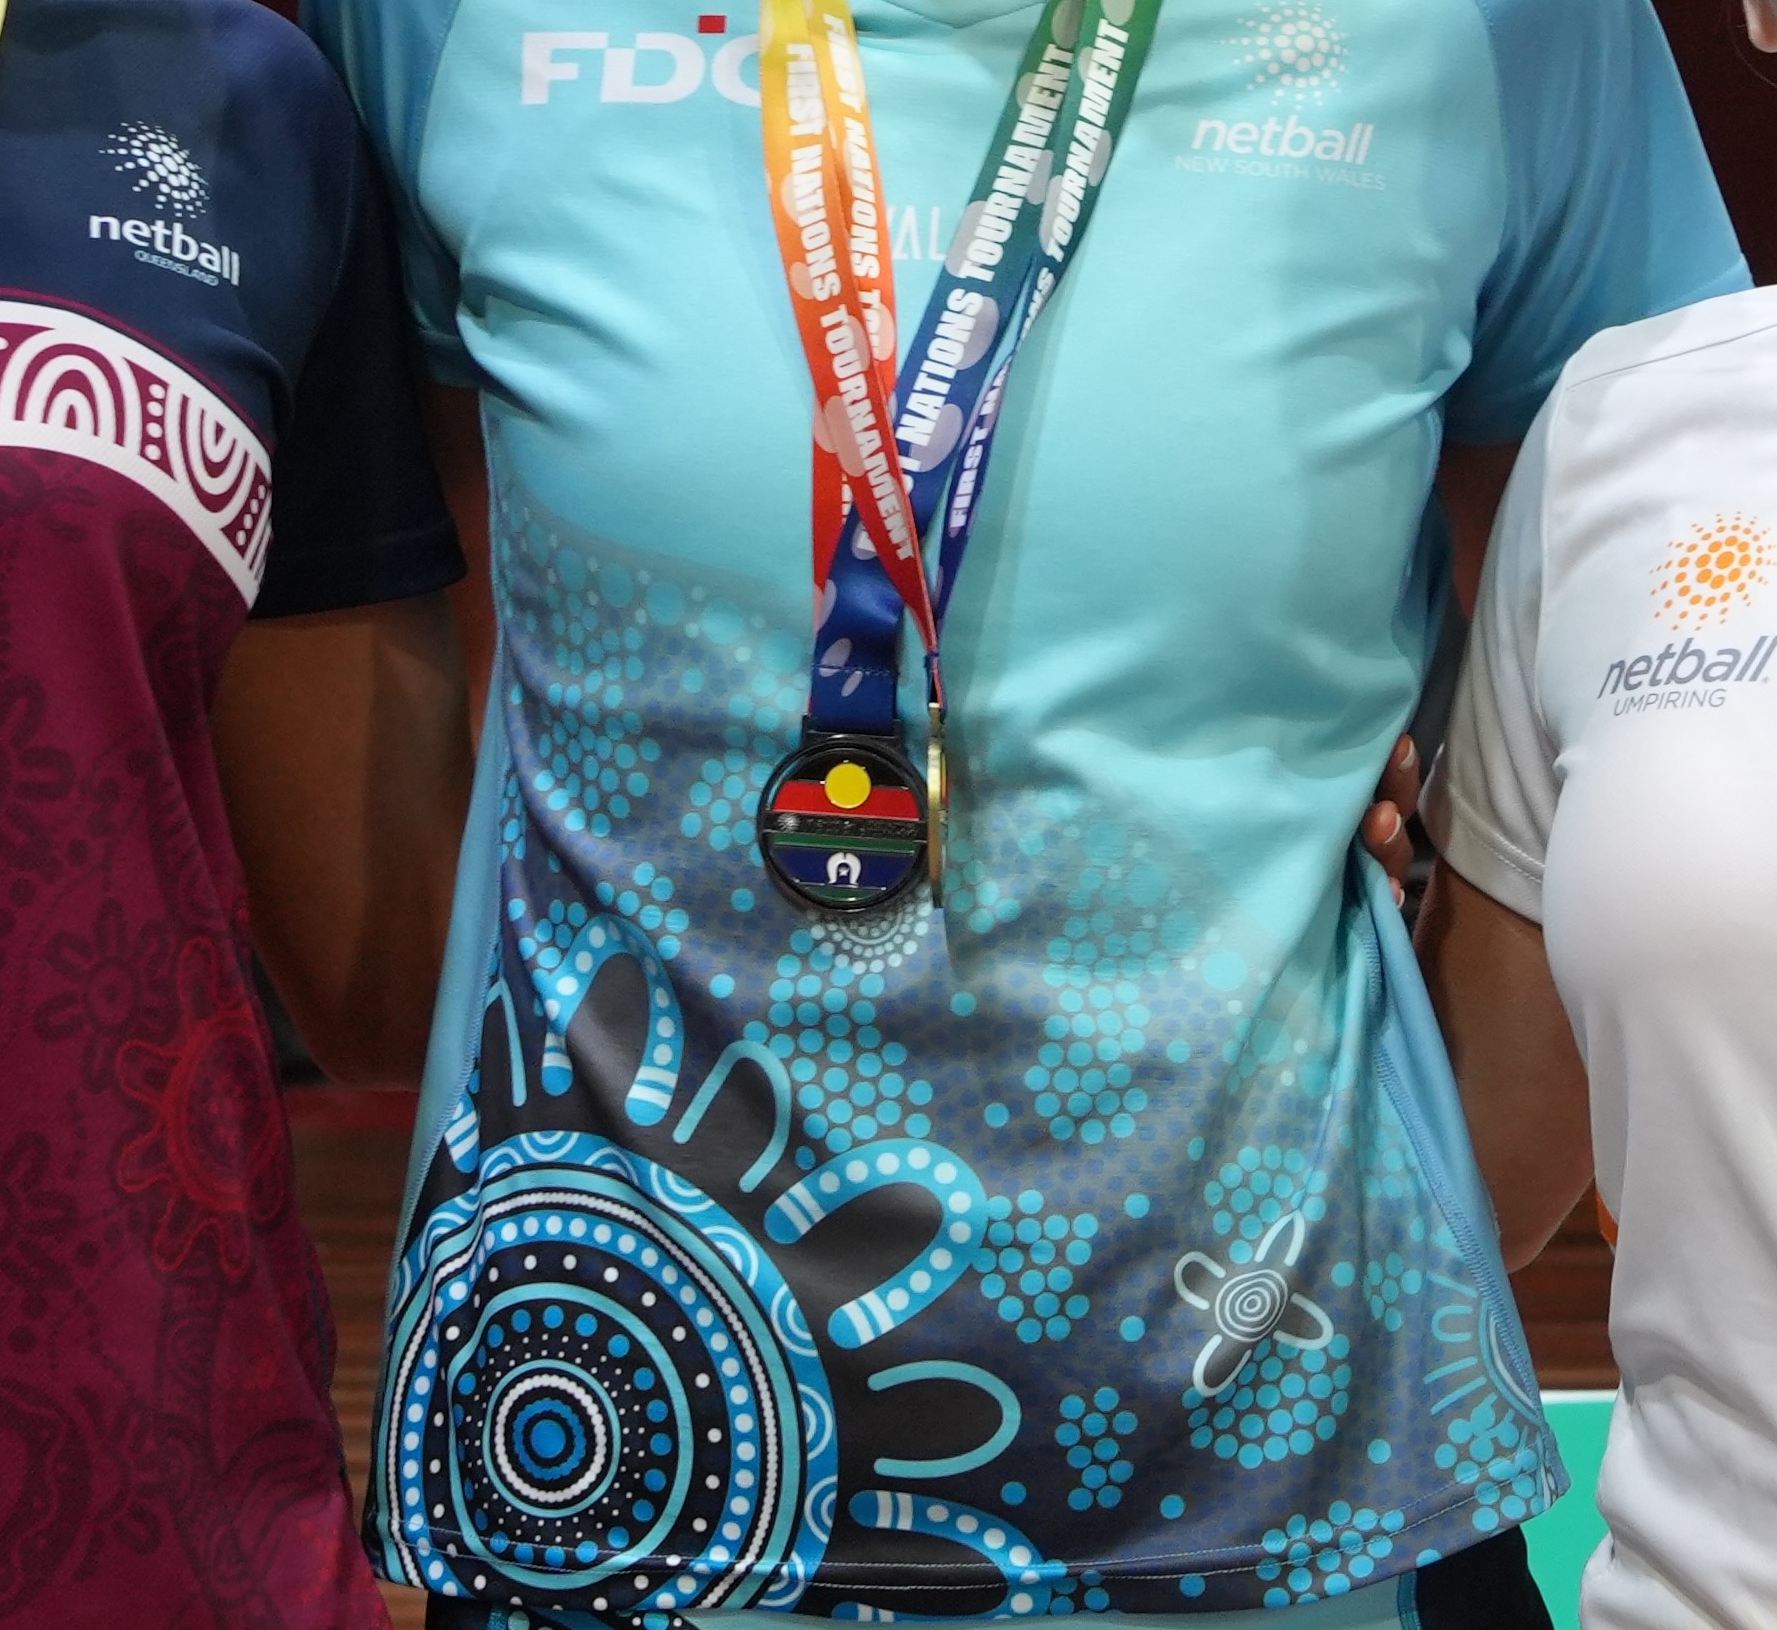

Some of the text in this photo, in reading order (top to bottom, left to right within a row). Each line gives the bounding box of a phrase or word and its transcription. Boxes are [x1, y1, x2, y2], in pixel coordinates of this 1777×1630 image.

[785, 43, 827, 137] FIRST
[822, 13, 866, 113] FIRST
[1175, 156, 1386, 191] NEW SOUTH WALES
[1192, 115, 1375, 165] netball
[790, 143, 843, 301] NATIONS
[843, 117, 881, 279] NATIONS
[895, 287, 985, 447] NATIONS
[959, 42, 1075, 283] TOURNAMENT
[89, 215, 240, 287] netball
[134, 249, 220, 287] QUEENSLAND
[949, 17, 1129, 529] FIRST TOURNAMENT
[820, 303, 915, 561] TOURNAMENT
[1613, 688, 1727, 717] UMPIRING
